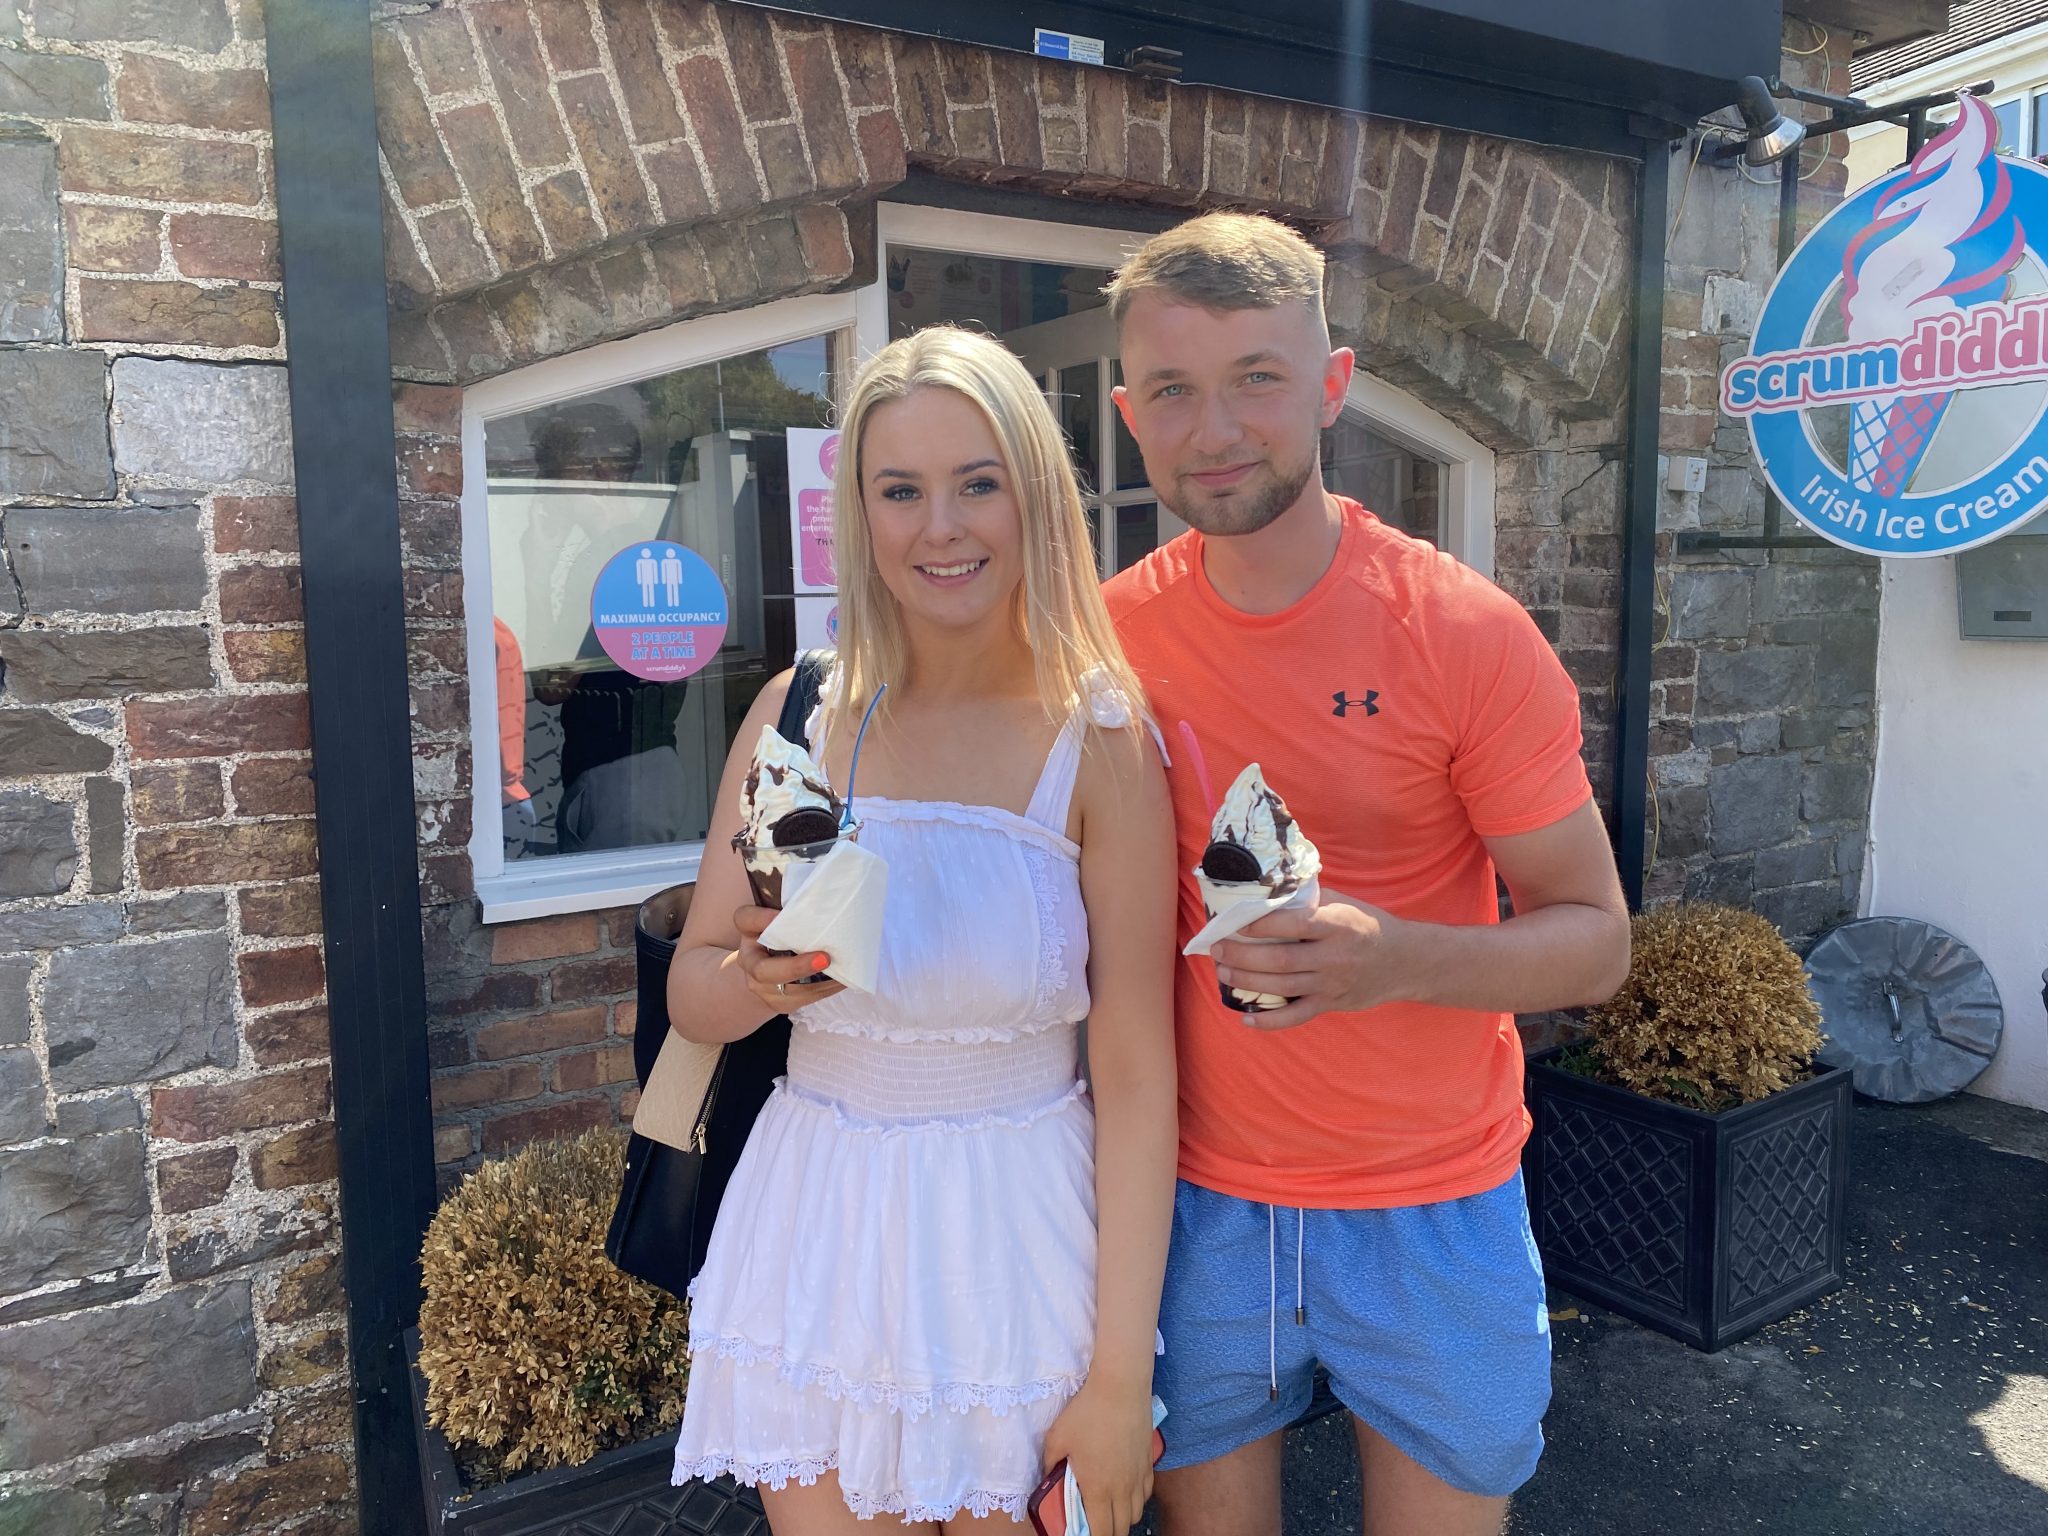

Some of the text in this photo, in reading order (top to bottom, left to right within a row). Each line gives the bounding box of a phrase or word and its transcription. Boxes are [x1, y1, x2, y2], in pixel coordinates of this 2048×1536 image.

[1800, 455, 2048, 540] Irish Ice Cream
[600, 612, 721, 624] MAXIMUM OCCUPANCY
[631, 631, 695, 645] 2 PEOPLE
[631, 645, 696, 660] AT A TIME
